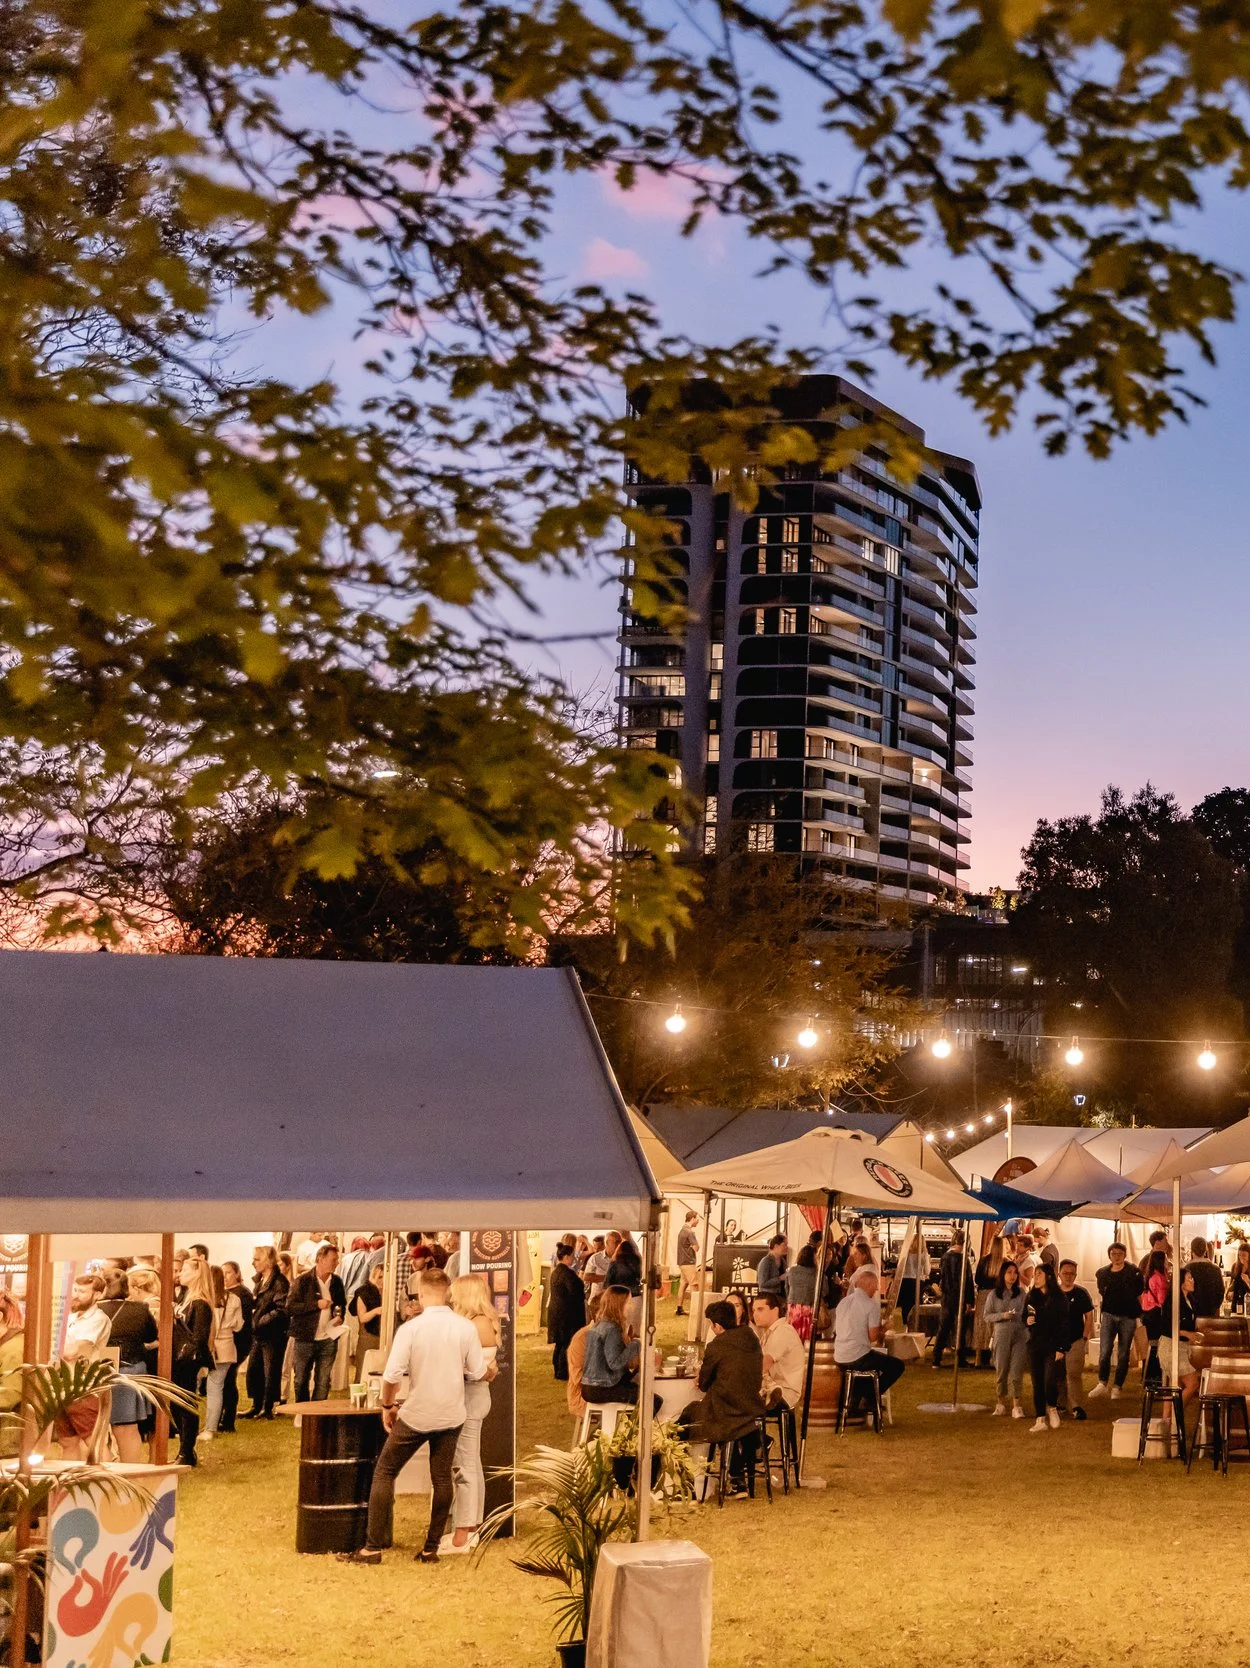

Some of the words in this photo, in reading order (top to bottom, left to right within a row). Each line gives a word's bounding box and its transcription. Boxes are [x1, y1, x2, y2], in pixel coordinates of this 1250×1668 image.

[725, 1181, 758, 1190] ORIGINAL
[5, 1264, 28, 1273] POURI
[486, 1262, 512, 1270] POURING
